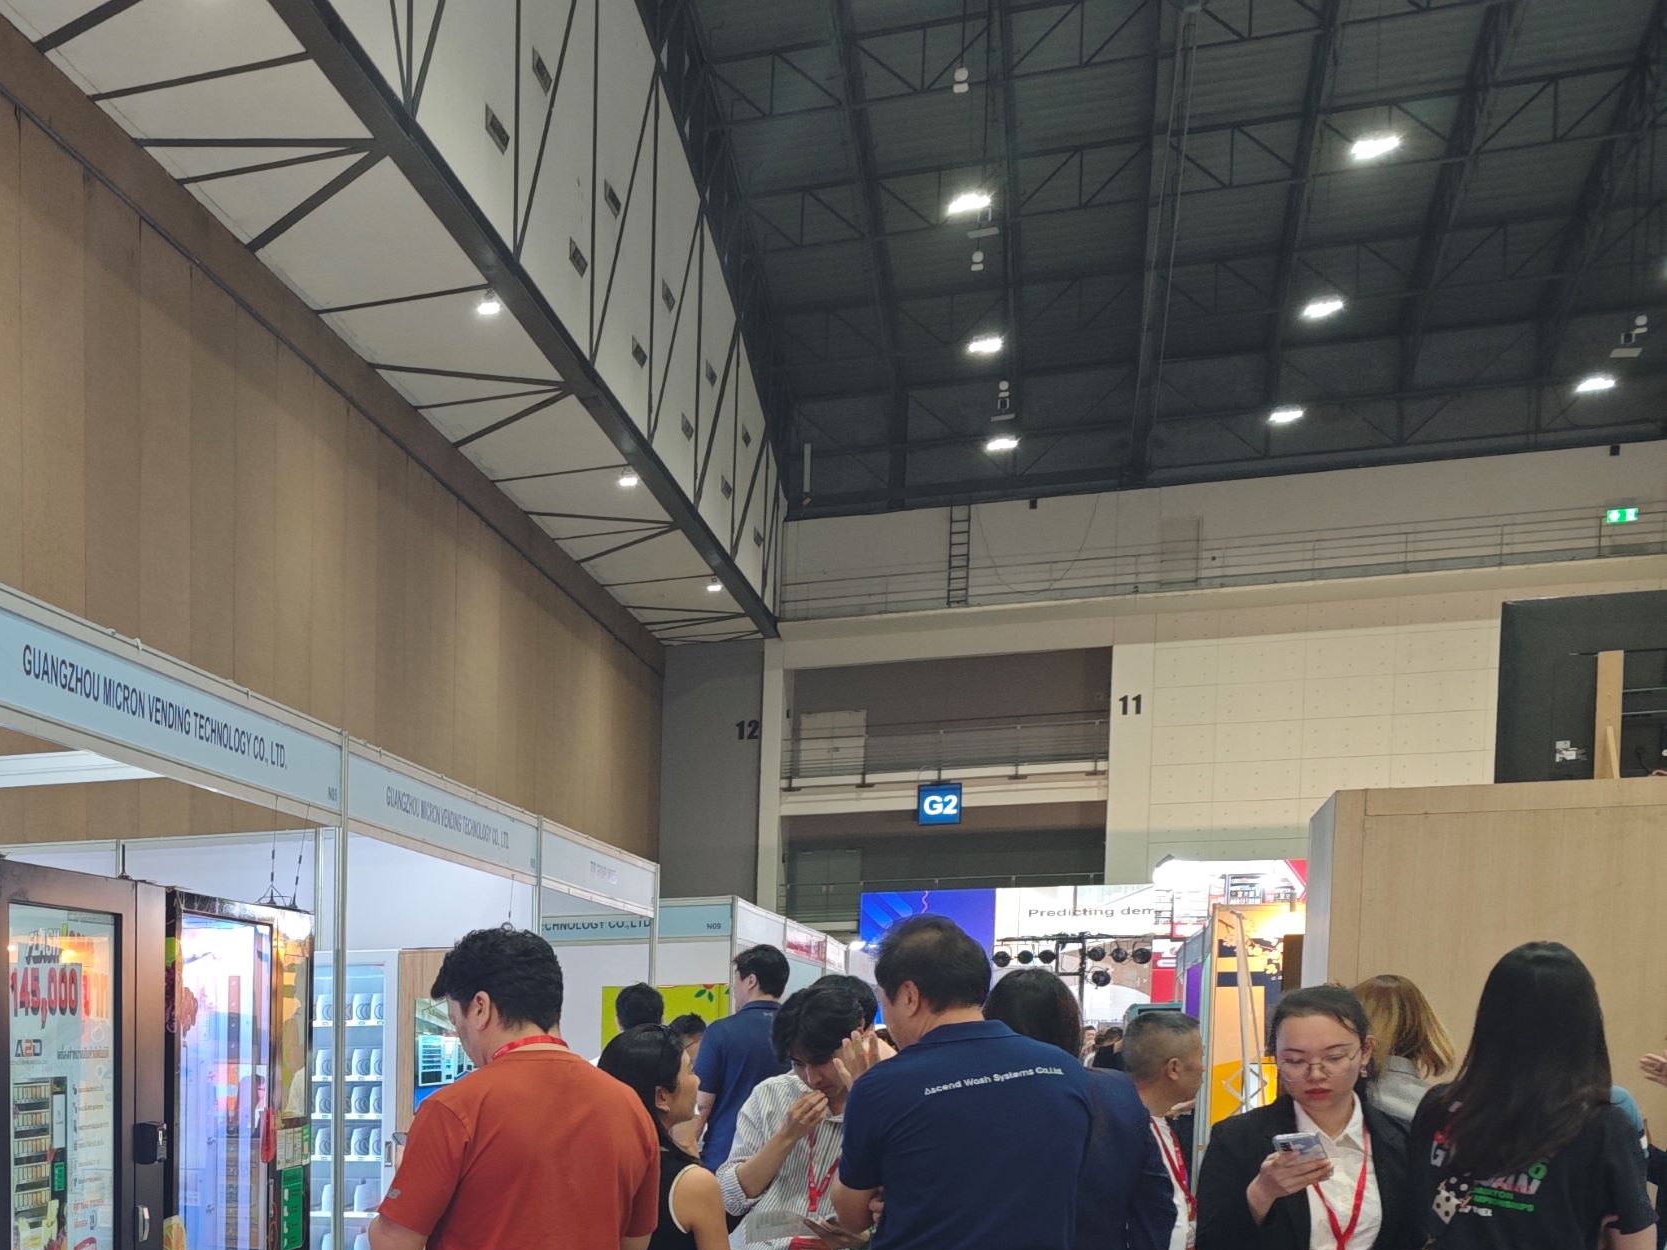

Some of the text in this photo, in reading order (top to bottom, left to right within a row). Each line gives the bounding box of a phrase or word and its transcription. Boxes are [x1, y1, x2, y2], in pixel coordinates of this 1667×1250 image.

[22, 644, 100, 703] GUANGZHOU
[103, 675, 146, 720] MICRON
[147, 694, 191, 736] VENDING
[193, 711, 253, 757] TECHNOLOGY
[270, 741, 288, 770] LTD.
[1118, 693, 1143, 716] 11
[735, 719, 760, 741] 12
[385, 785, 420, 819] GUANGZHOU
[441, 807, 462, 833] VENDING
[922, 795, 958, 816] G2
[1028, 907, 1115, 918] Predicting
[10, 966, 79, 1030] 145,000
[14, 1038, 43, 1058] A2D
[924, 1080, 962, 1096] Ascend
[963, 1075, 992, 1087] Wash
[993, 1067, 1034, 1082] Systems
